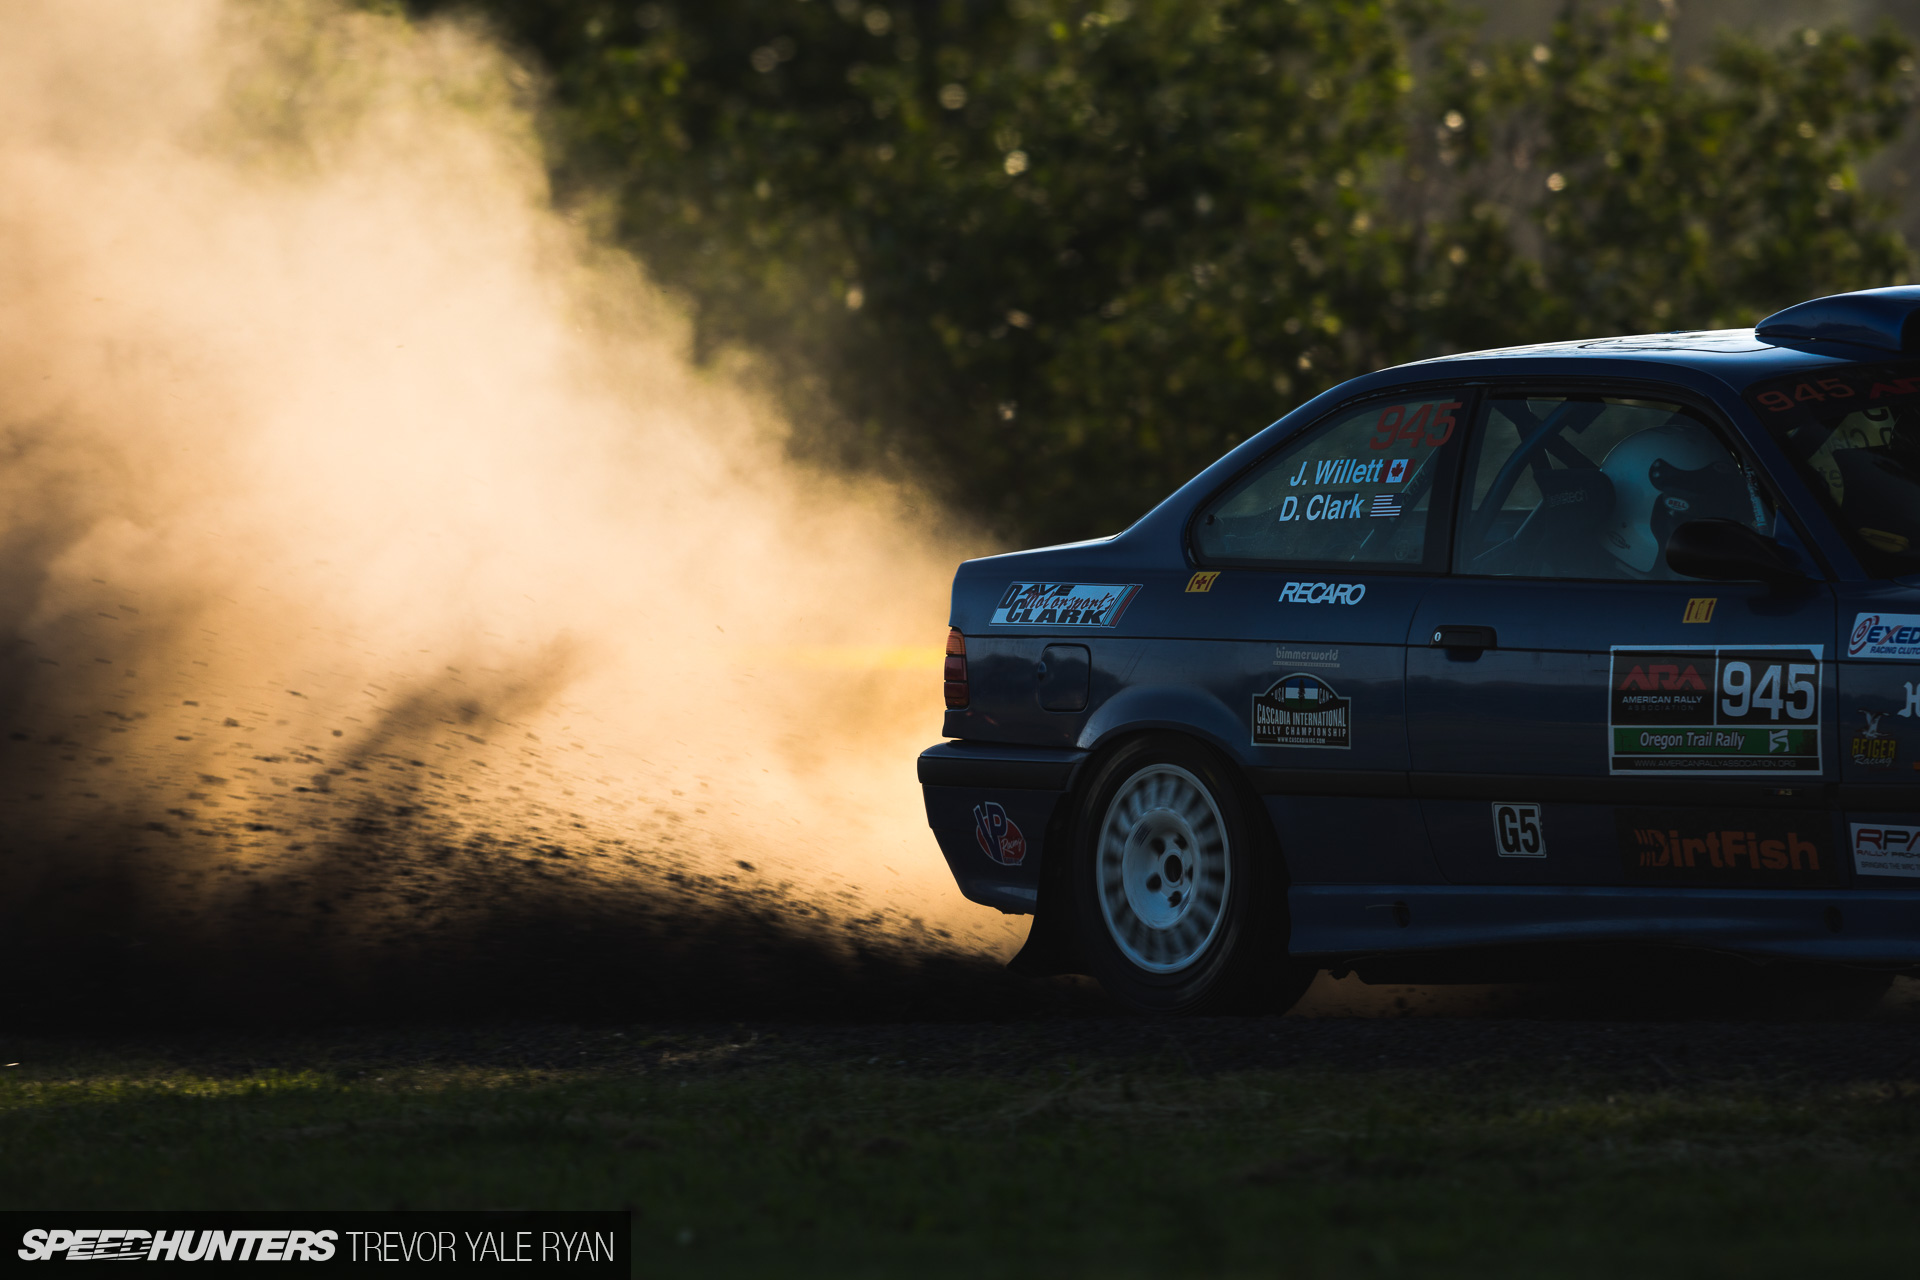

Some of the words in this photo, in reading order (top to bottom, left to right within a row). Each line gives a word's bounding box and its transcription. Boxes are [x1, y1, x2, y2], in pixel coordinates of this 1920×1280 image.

[1756, 378, 1856, 412] 945
[1369, 402, 1463, 450] 945
[1290, 461, 1308, 486] J.
[1315, 458, 1384, 485] Willett
[1279, 496, 1300, 521] D.
[1306, 493, 1365, 521] Clark
[1668, 499, 1687, 509] BELL
[998, 584, 1076, 609] DAVE
[1278, 581, 1366, 605] RECARO
[1005, 598, 1106, 624] CLARK
[1275, 646, 1339, 661] bimmerworld
[1870, 646, 1897, 655] RACING
[1616, 664, 1707, 690] ARA
[1274, 687, 1285, 703] USA
[1318, 688, 1330, 704] CAN
[1622, 696, 1672, 704] AMERICAN
[1674, 696, 1703, 704] RALLY
[1721, 661, 1816, 720] 945
[1256, 703, 1291, 725] CASCADIA
[1293, 707, 1346, 727] INTERNATIONAL
[1256, 726, 1282, 735] RALLY
[1285, 726, 1346, 737] CHAMPIONSHIP
[1639, 731, 1683, 750] Oregon
[1686, 732, 1712, 747] Trail
[1715, 732, 1745, 750] Rally
[1634, 760, 1796, 768] WWW.AMERICANRALLYASSOCIATION.ORG
[1853, 754, 1893, 767] Racing
[973, 801, 1008, 864] VP
[1498, 806, 1540, 853] G5
[1634, 829, 1820, 870] DirtFish
[1856, 849, 1888, 857] RALLY
